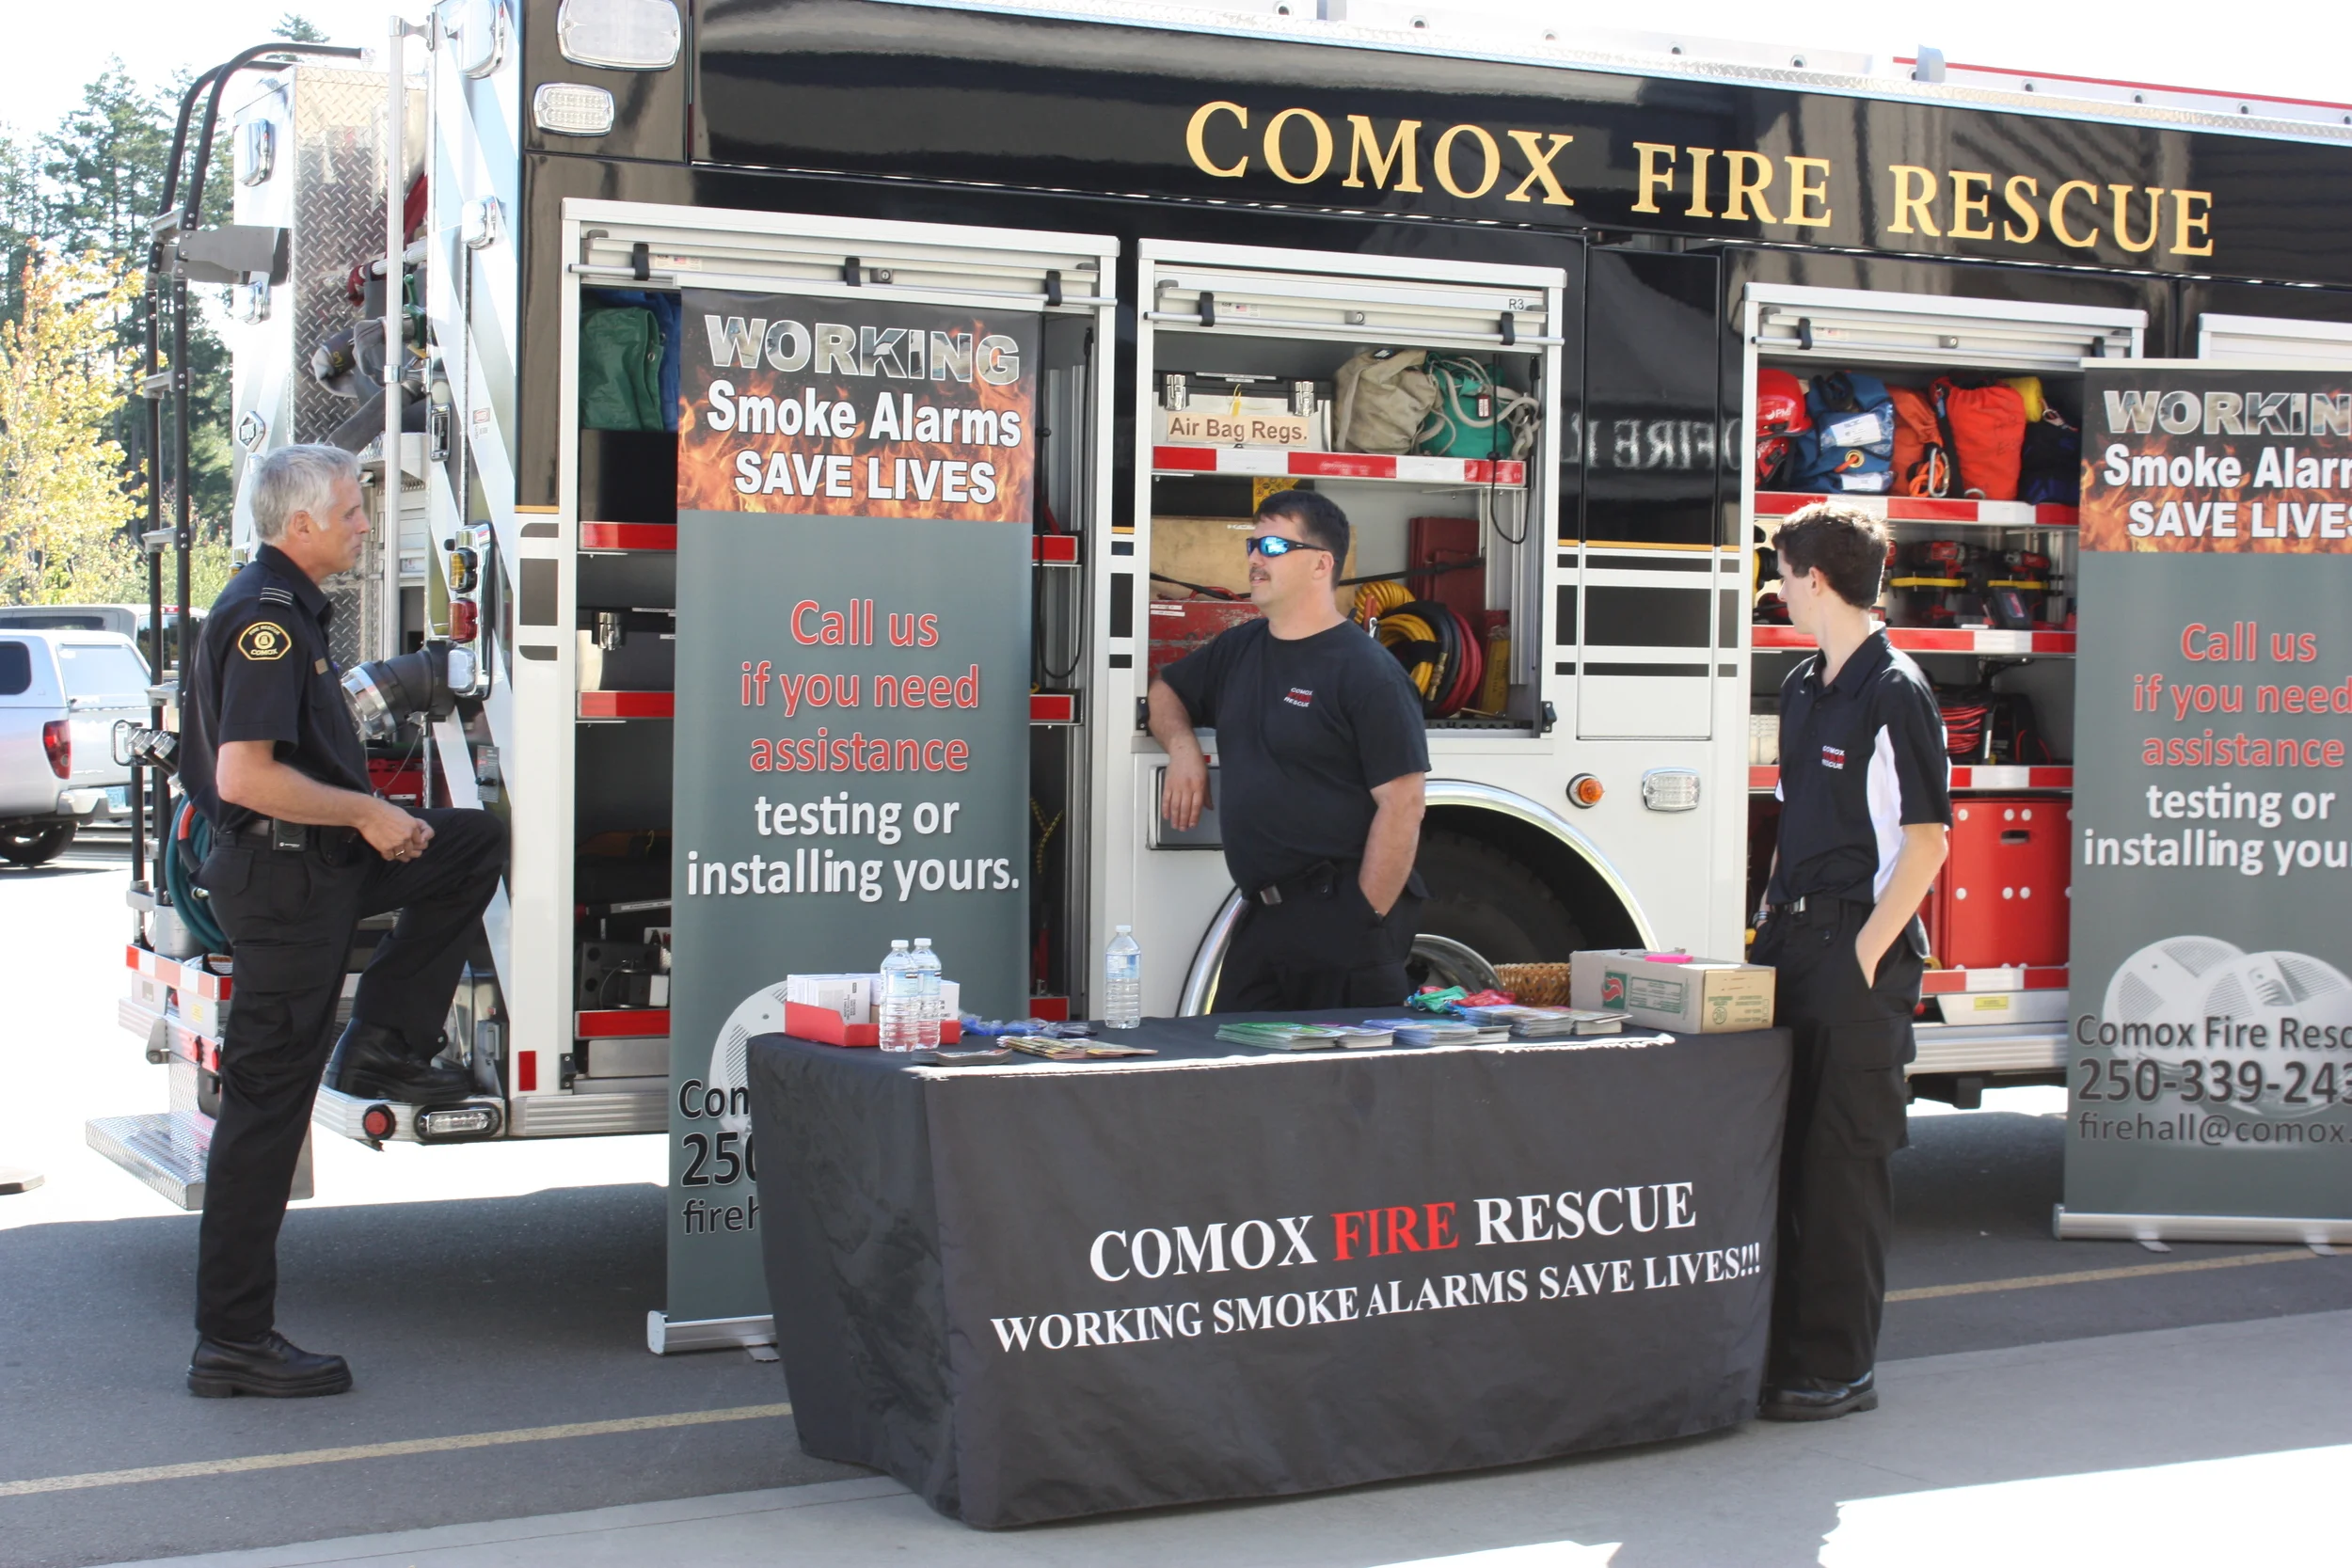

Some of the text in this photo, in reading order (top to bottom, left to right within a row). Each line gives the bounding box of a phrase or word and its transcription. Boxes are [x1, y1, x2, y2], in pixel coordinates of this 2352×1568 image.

[1186, 102, 2215, 257] COMOX FIRE RESCUE
[1508, 298, 1524, 310] R3
[704, 314, 1021, 385] WORKING
[707, 379, 1022, 448] Smoke Alarms
[1169, 418, 1308, 444] Air Bag Regs.
[735, 450, 996, 504] SAVE LIVES
[2104, 443, 2242, 489] Smoke
[2127, 500, 2352, 539] SAVE LIVE
[790, 598, 939, 647] Call us
[2181, 621, 2317, 662] Call us
[741, 660, 978, 717] if you need
[2133, 673, 2352, 721] if you need
[750, 727, 968, 772] assistance
[2141, 729, 2345, 768] assistance
[755, 791, 960, 845] testing or
[2145, 782, 2336, 828] testing or
[688, 848, 1019, 902] installing yours.
[2084, 828, 2265, 876] installing
[2076, 1015, 2194, 1047] Comox
[2205, 1016, 2267, 1048] Fire
[1089, 1181, 1696, 1282] COMOX FIRE RESCUE
[991, 1243, 1761, 1353] WORKING SMOKE ALARMS SAVE LIVES!!!
